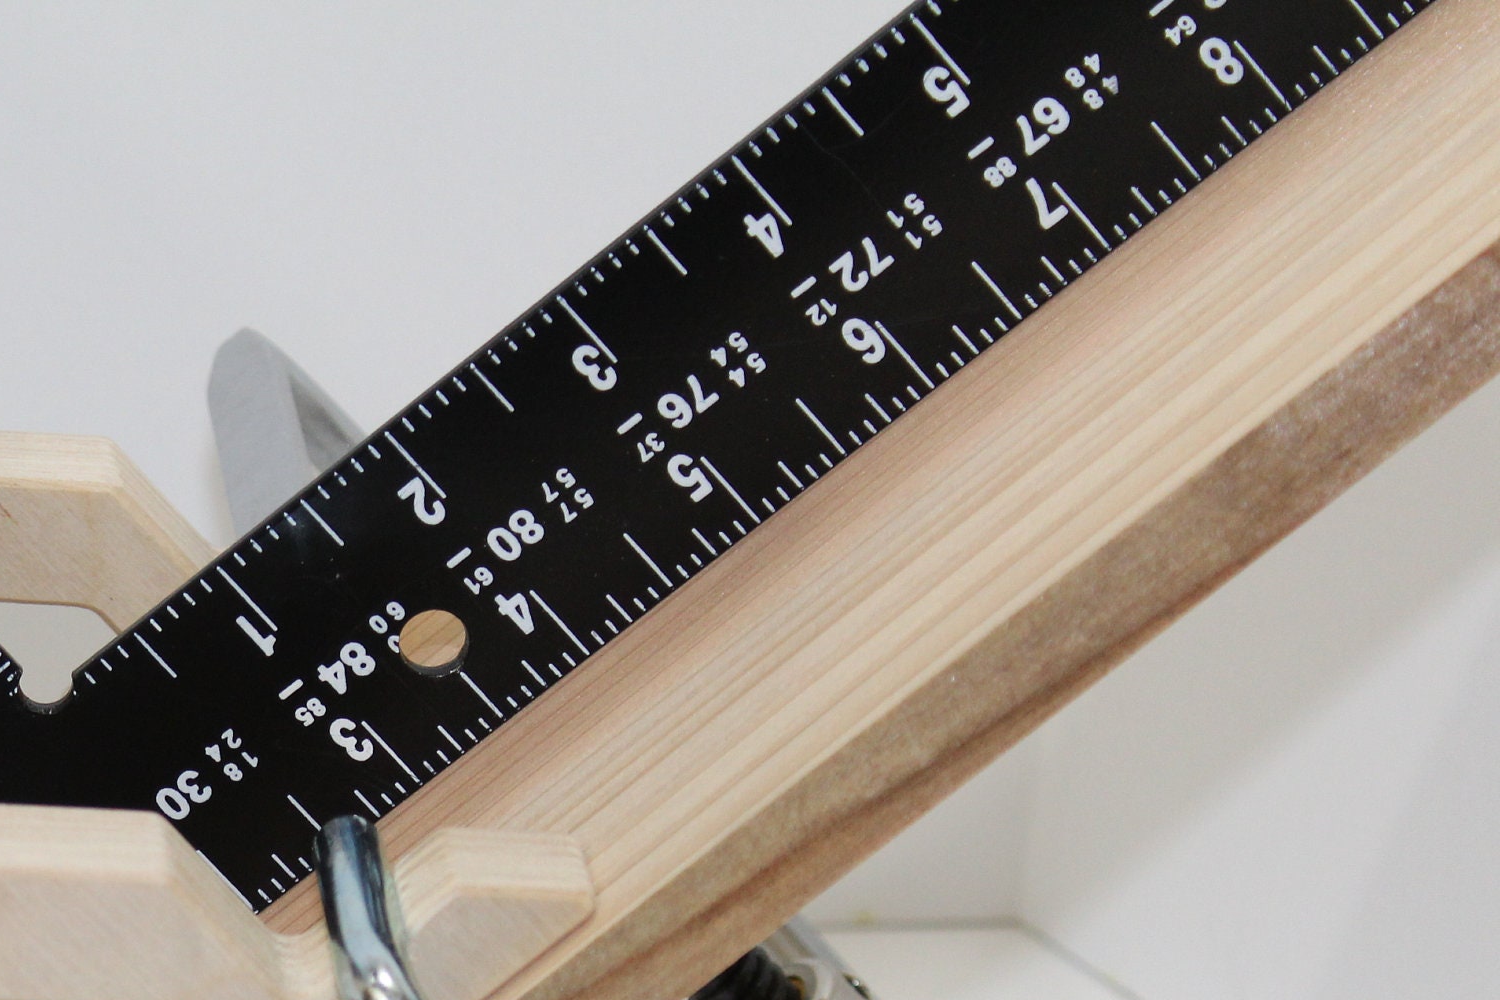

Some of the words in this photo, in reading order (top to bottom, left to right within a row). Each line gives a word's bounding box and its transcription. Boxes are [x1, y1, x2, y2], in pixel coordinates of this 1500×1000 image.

[1164, 15, 1197, 46] 64
[1198, 36, 1244, 85] 8
[922, 66, 970, 118] 5
[1016, 97, 1071, 156] 67
[983, 156, 1018, 188] 88
[1025, 177, 1069, 230] 7
[743, 213, 785, 258] 4
[828, 236, 895, 292] 72
[804, 298, 837, 327] 12
[841, 317, 886, 364] 6
[571, 344, 618, 392] 3
[657, 374, 720, 429] 76
[636, 432, 665, 463] 37
[397, 476, 446, 526] 2
[666, 453, 714, 503] 5
[486, 509, 545, 562] 80
[463, 566, 494, 595] 61
[235, 615, 277, 657] 1
[494, 592, 535, 635] 4
[317, 641, 376, 695] 84
[294, 697, 327, 727] 85
[329, 718, 374, 762] 3
[155, 770, 213, 820] 30
